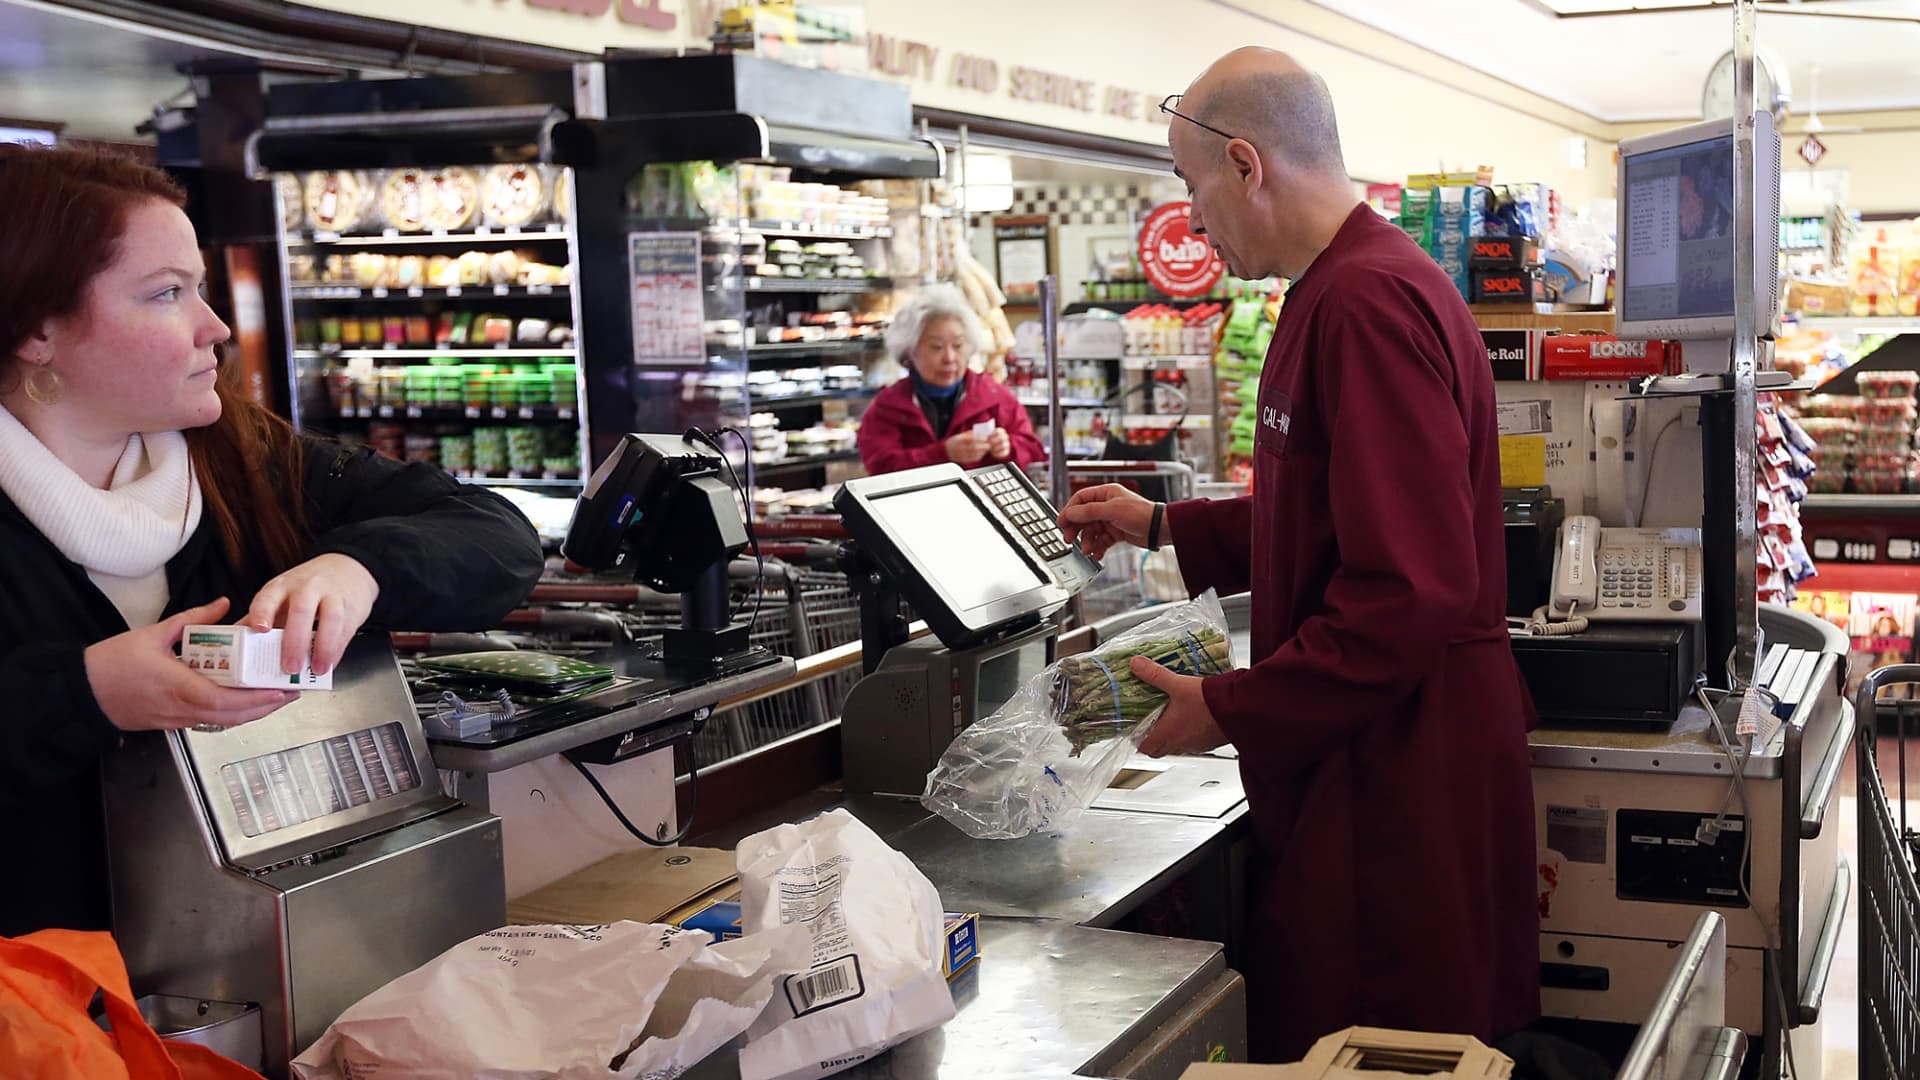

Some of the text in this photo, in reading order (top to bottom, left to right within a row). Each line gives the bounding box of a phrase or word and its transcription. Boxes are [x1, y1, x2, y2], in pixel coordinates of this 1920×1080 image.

[1474, 242, 1513, 258] SKOR
[1483, 277, 1524, 293] SKOR
[1498, 349, 1524, 360] Roll
[1590, 341, 1647, 359] LOOK!
